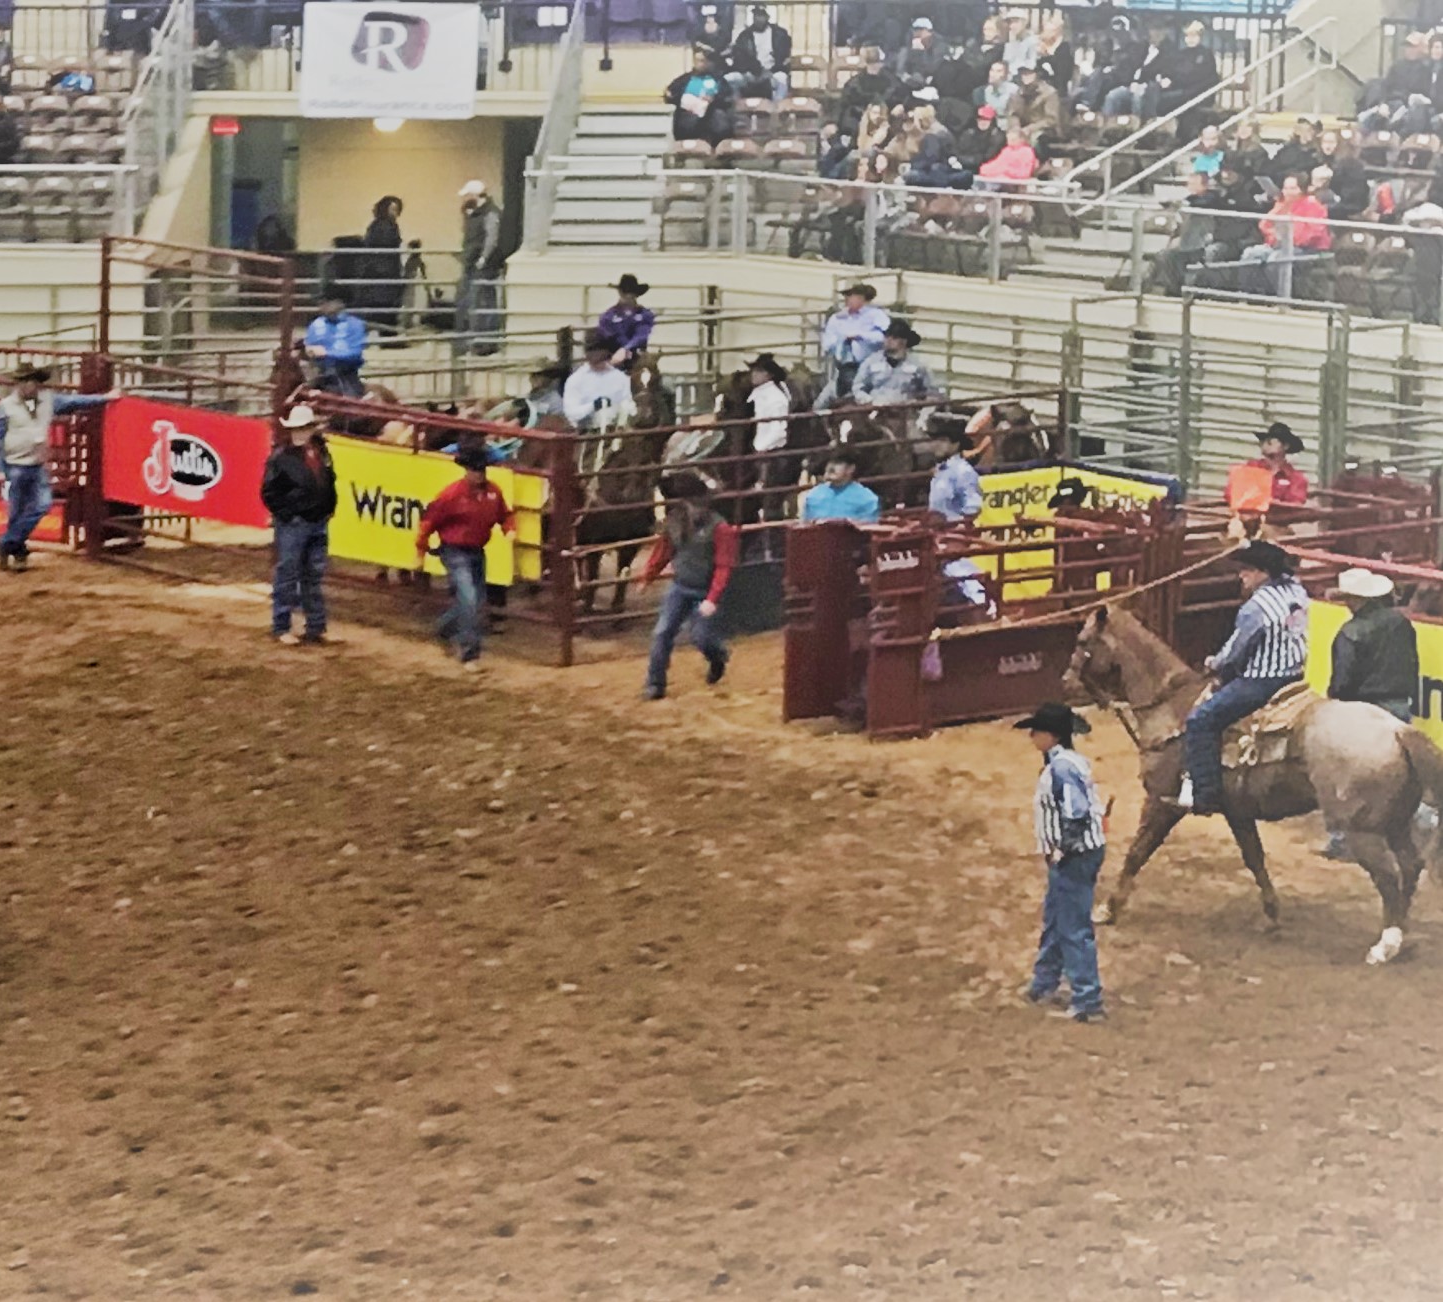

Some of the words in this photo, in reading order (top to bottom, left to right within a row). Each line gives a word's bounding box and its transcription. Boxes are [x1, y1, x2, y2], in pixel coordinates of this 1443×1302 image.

[361, 20, 407, 73] R
[143, 419, 214, 494] Justin
[350, 480, 428, 530] Wran
